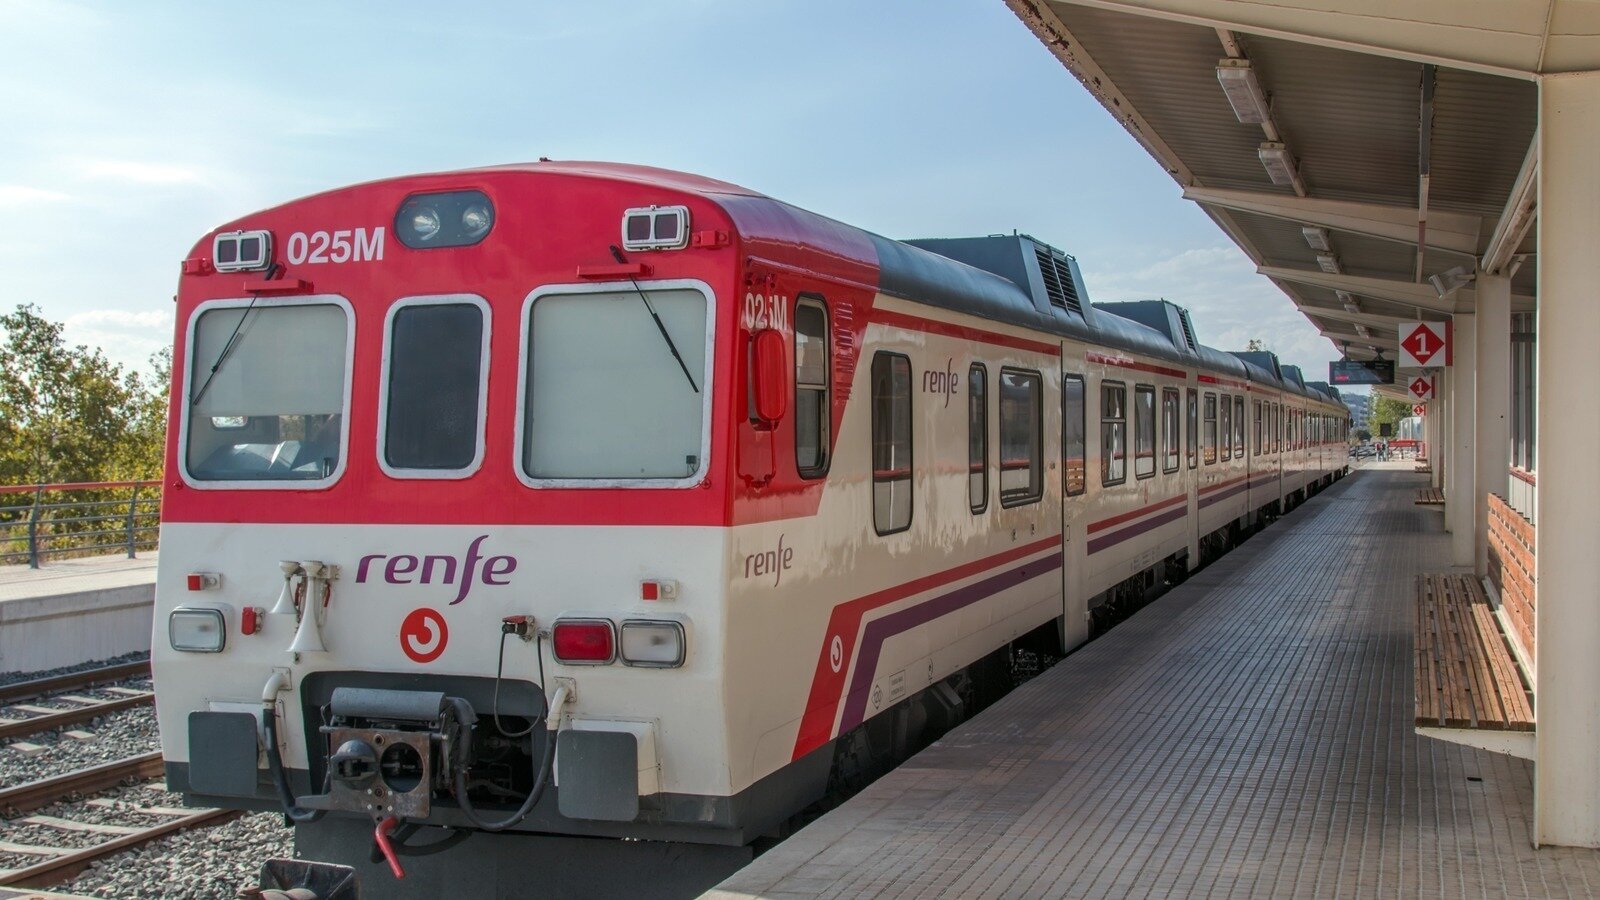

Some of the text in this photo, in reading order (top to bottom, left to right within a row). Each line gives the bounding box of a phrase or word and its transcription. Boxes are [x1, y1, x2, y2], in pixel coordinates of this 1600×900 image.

[287, 226, 385, 265] 025M
[1415, 332, 1431, 356] 1
[923, 357, 959, 408] renfe
[1417, 382, 1424, 394] 1
[355, 534, 518, 605] renfe
[744, 533, 793, 588] renfe
